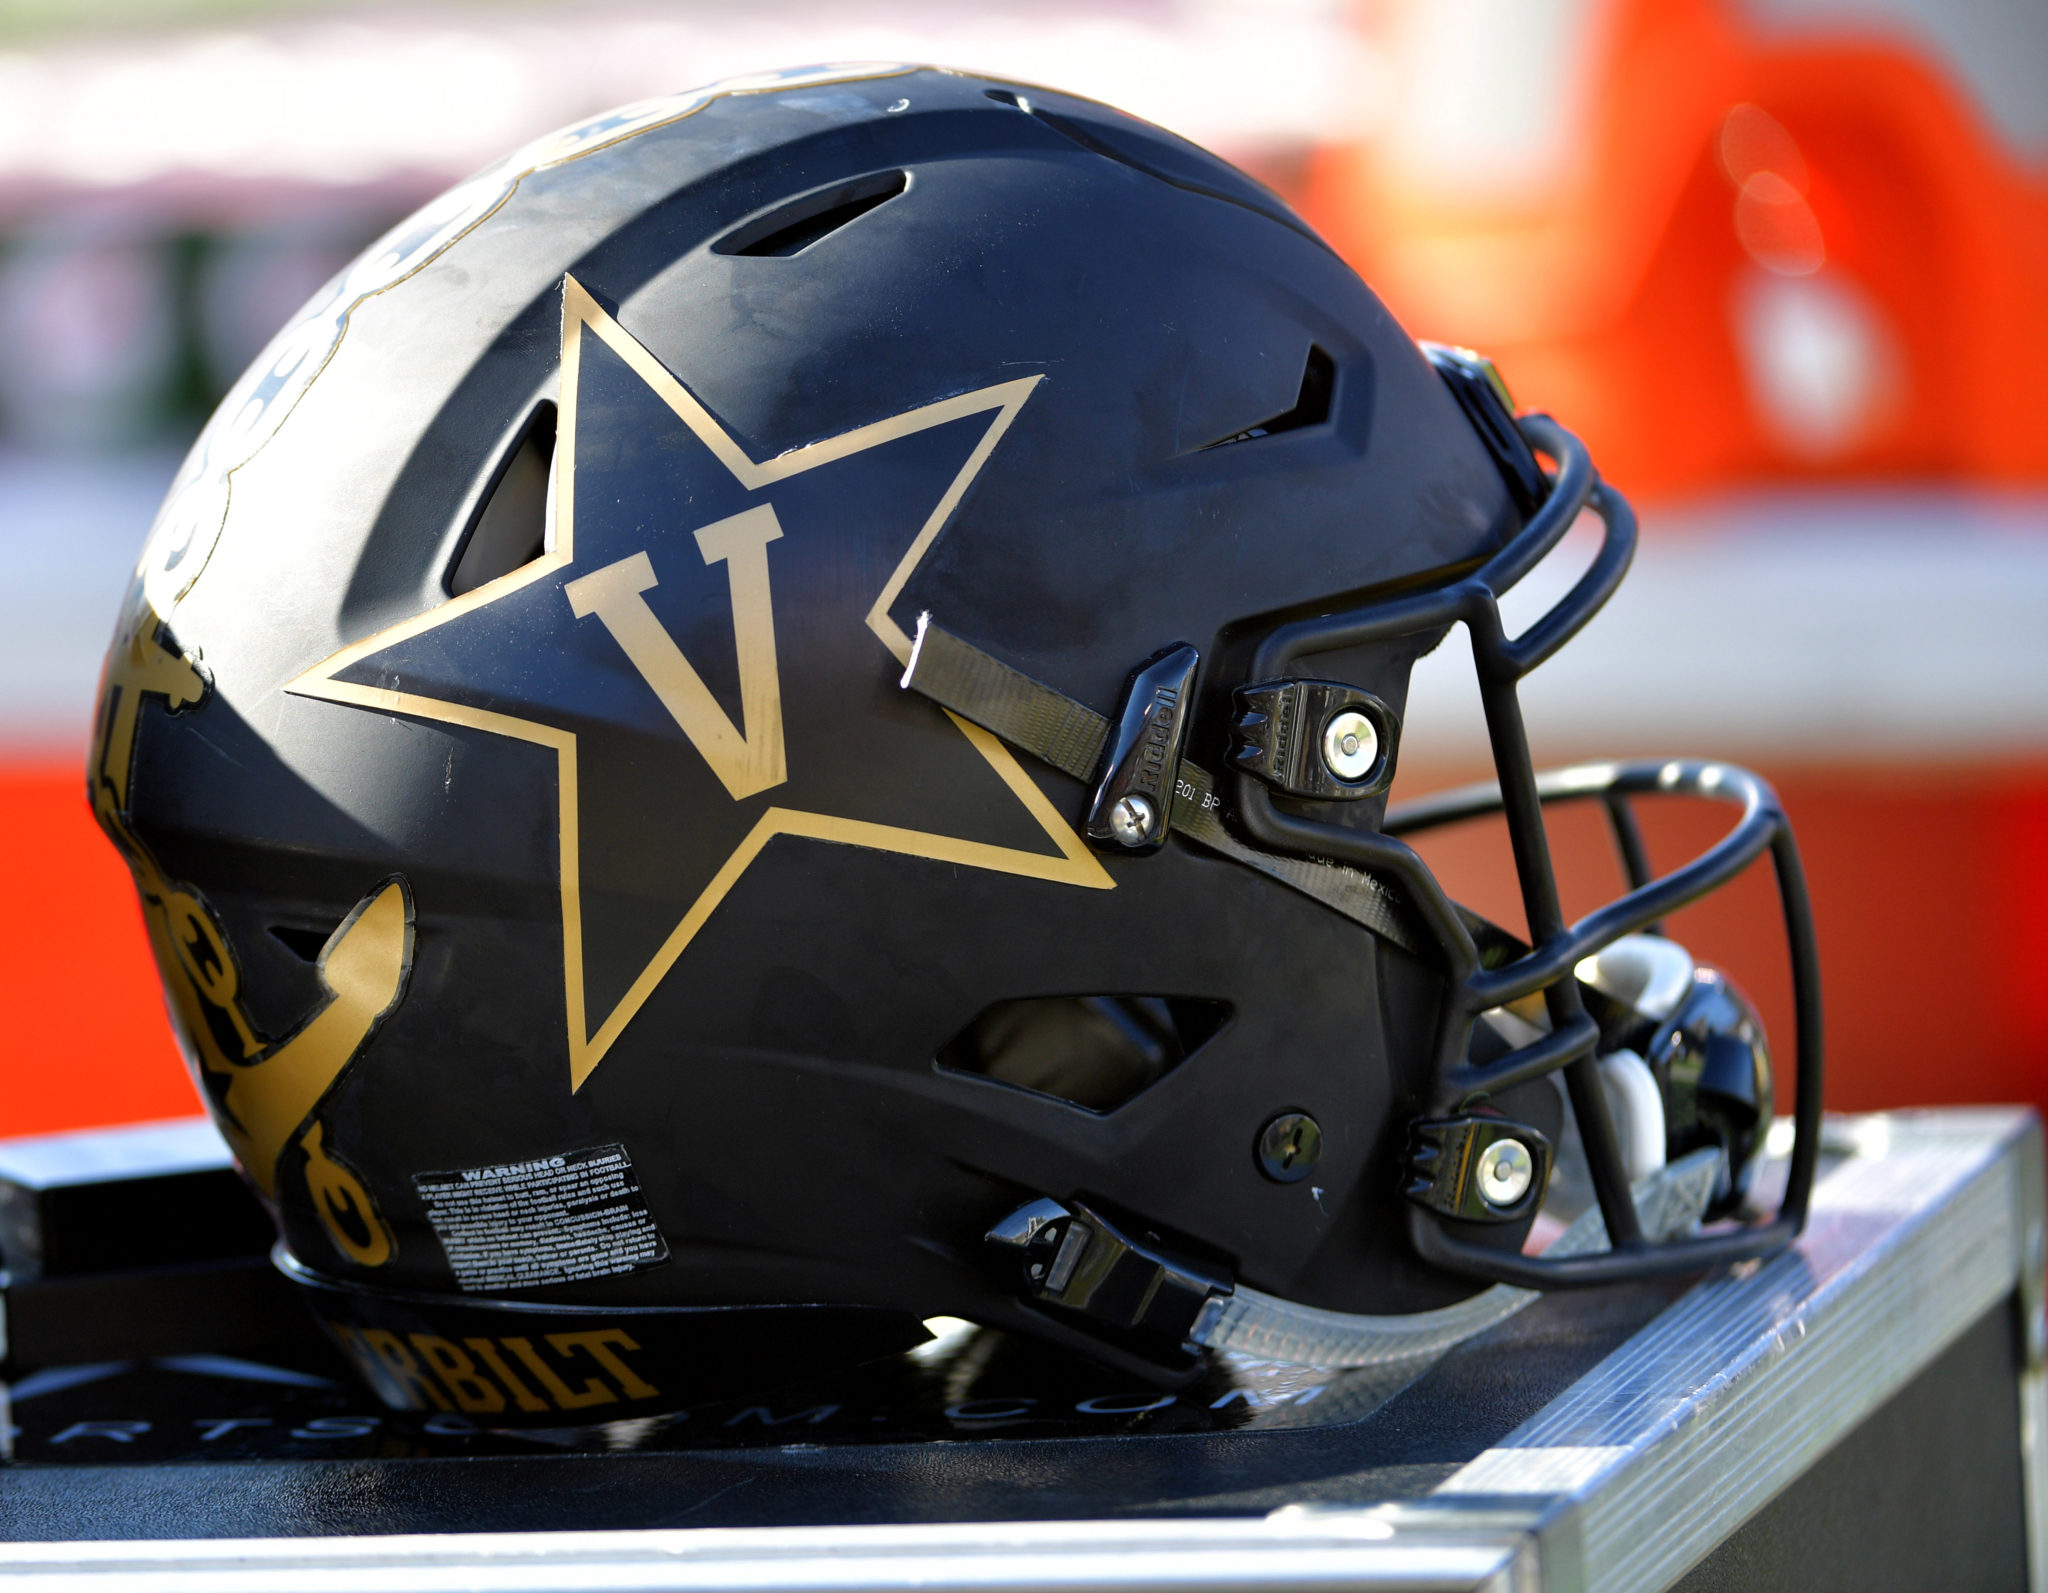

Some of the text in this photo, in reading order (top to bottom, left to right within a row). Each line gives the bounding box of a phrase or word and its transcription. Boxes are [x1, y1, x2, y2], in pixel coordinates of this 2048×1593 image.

[564, 502, 788, 802] V
[1201, 792, 1221, 811] BP
[1343, 861, 1355, 877] in
[461, 1158, 567, 1181] WARNING
[470, 1179, 501, 1188] PREVENT
[502, 1173, 533, 1183] SERIOUS
[534, 1170, 554, 1179] HEAD
[556, 1167, 567, 1175] OR
[568, 1162, 588, 1173] NECK
[588, 1154, 621, 1168] INJURIES
[504, 1182, 526, 1192] WHILE
[528, 1175, 579, 1189] PARTICIPATING
[532, 1189, 548, 1197] ram,
[558, 1184, 578, 1193] spear
[590, 1172, 624, 1186] opposing
[530, 1193, 557, 1205] football
[558, 1191, 576, 1199] rules
[577, 1188, 591, 1196] and
[566, 1196, 599, 1208] paralysis
[609, 1188, 630, 1197] death
[517, 1216, 533, 1225] your
[564, 1221, 601, 1232] Symptoms
[601, 1214, 630, 1225] include:
[631, 1209, 648, 1218] loss
[611, 1222, 636, 1231] nausea
[615, 1229, 642, 1239] playing
[643, 1224, 656, 1232] and
[625, 1236, 647, 1244] return
[591, 1252, 608, 1261] gone
[610, 1248, 624, 1256] and
[625, 1246, 638, 1256] you
[639, 1241, 657, 1249] have
[610, 1254, 639, 1265] warning
[640, 1249, 655, 1258] may
[331, 1321, 662, 1416] RBILT
